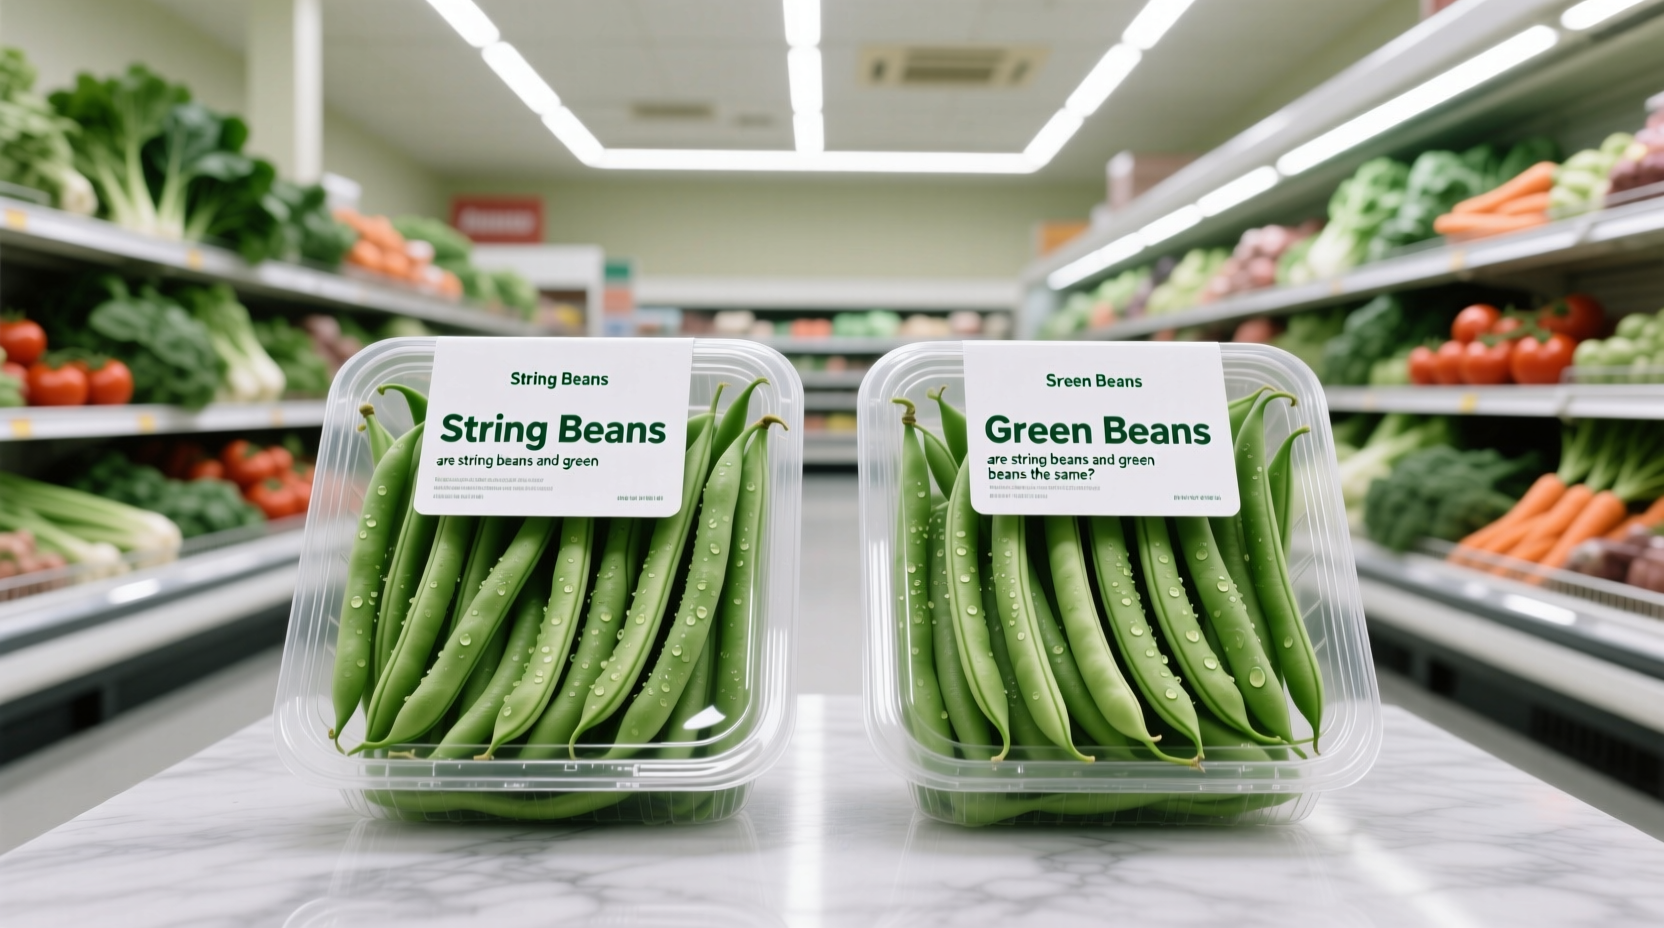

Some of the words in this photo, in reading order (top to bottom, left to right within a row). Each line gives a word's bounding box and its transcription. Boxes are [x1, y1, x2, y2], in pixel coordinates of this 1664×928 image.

[511, 372, 557, 389] String
[562, 372, 608, 385] Beans
[1096, 374, 1142, 387] Beans
[440, 413, 547, 451] String
[559, 415, 666, 444] Beans
[985, 415, 1092, 444] Green
[1104, 416, 1211, 445] Beans
[437, 457, 455, 466] are
[458, 455, 493, 468] string
[497, 454, 533, 466] beans
[537, 454, 559, 466] and
[563, 458, 598, 470] green
[987, 456, 1007, 465] are
[1012, 453, 1047, 467] string
[1051, 453, 1088, 465] beans
[1093, 454, 1115, 465] and
[1119, 457, 1154, 468] green
[988, 467, 1026, 480] beans
[1031, 467, 1050, 480] the
[1055, 468, 1095, 480] same?
